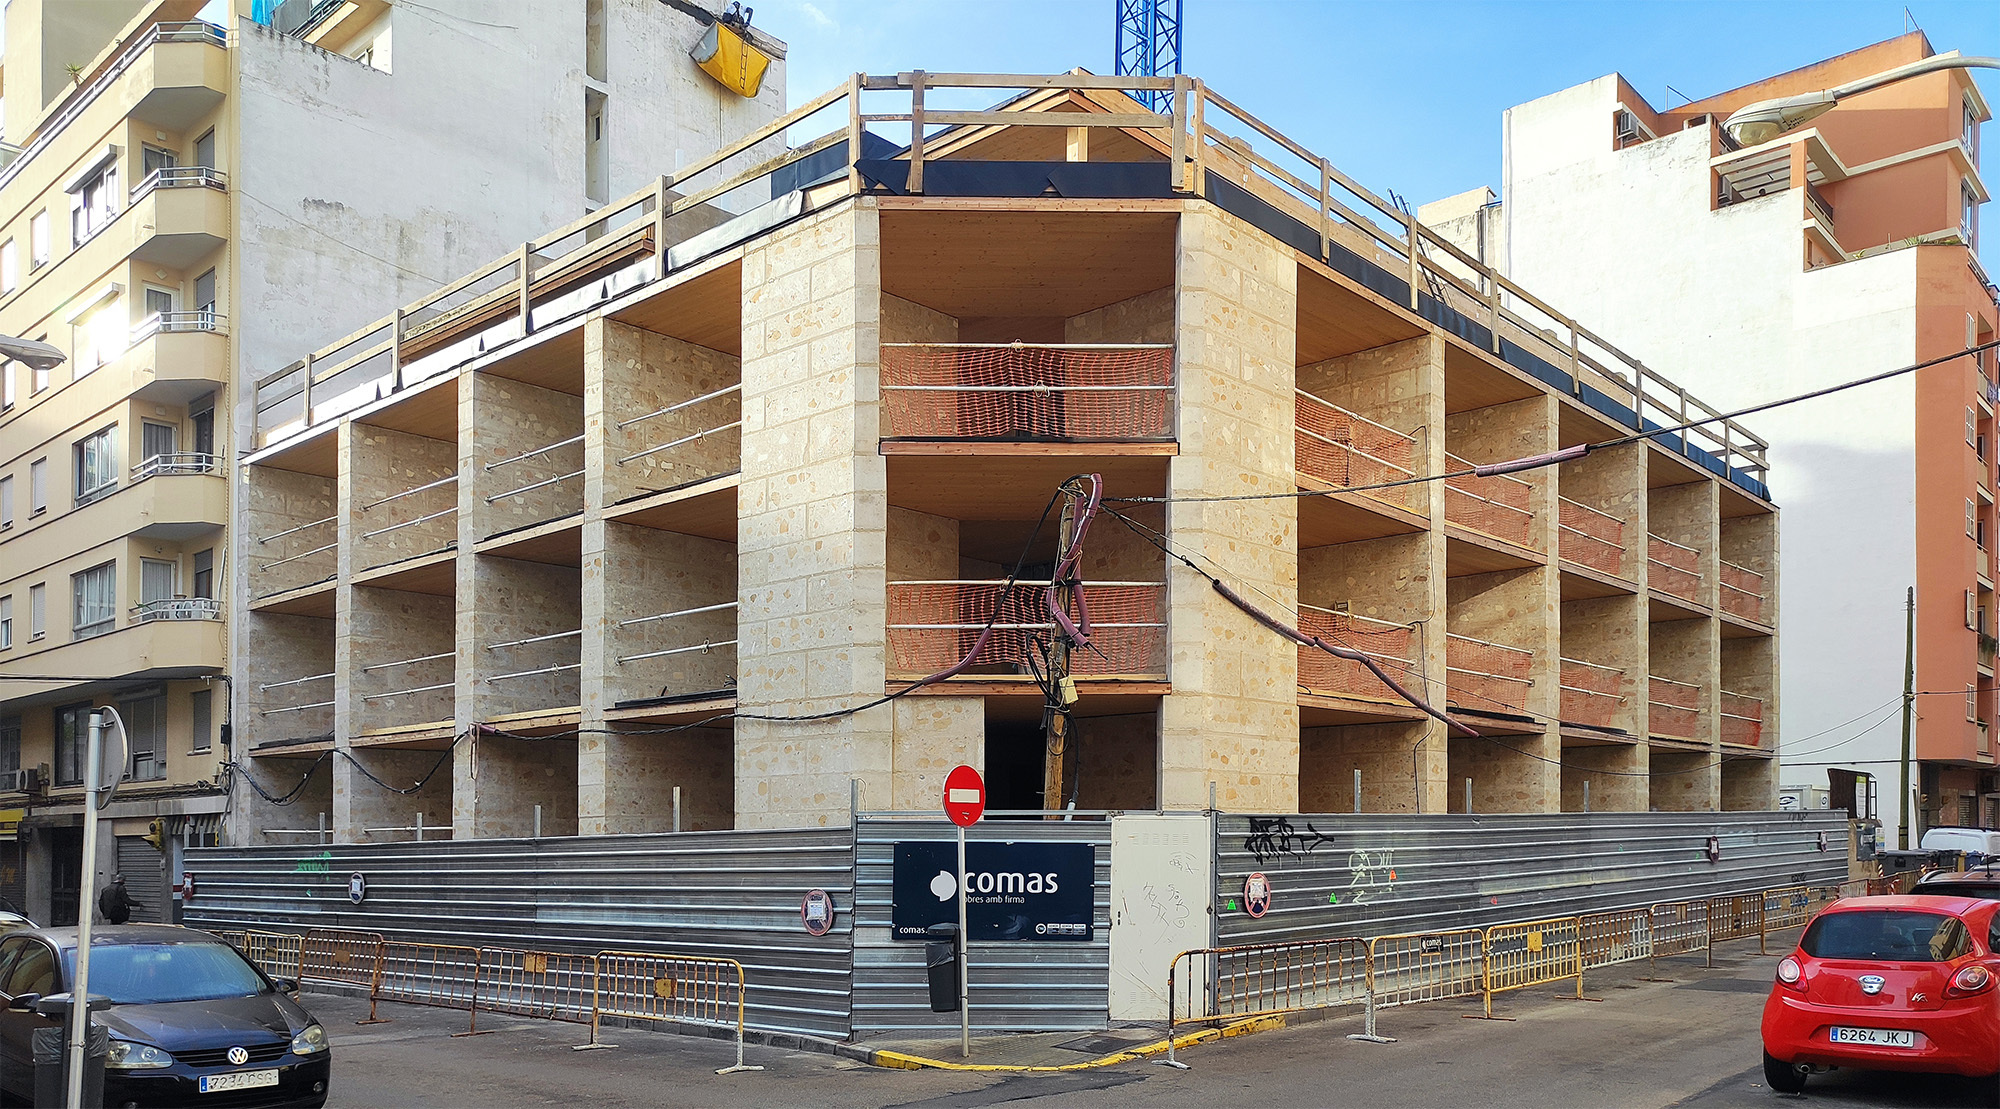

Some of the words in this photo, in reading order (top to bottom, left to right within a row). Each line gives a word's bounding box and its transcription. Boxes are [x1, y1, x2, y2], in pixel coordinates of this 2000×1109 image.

[965, 872, 1059, 894] comas
[985, 895, 1003, 904] amb
[1004, 894, 1025, 904] firma
[1840, 1028, 1876, 1043] 6264
[1882, 1031, 1910, 1045] JKJ
